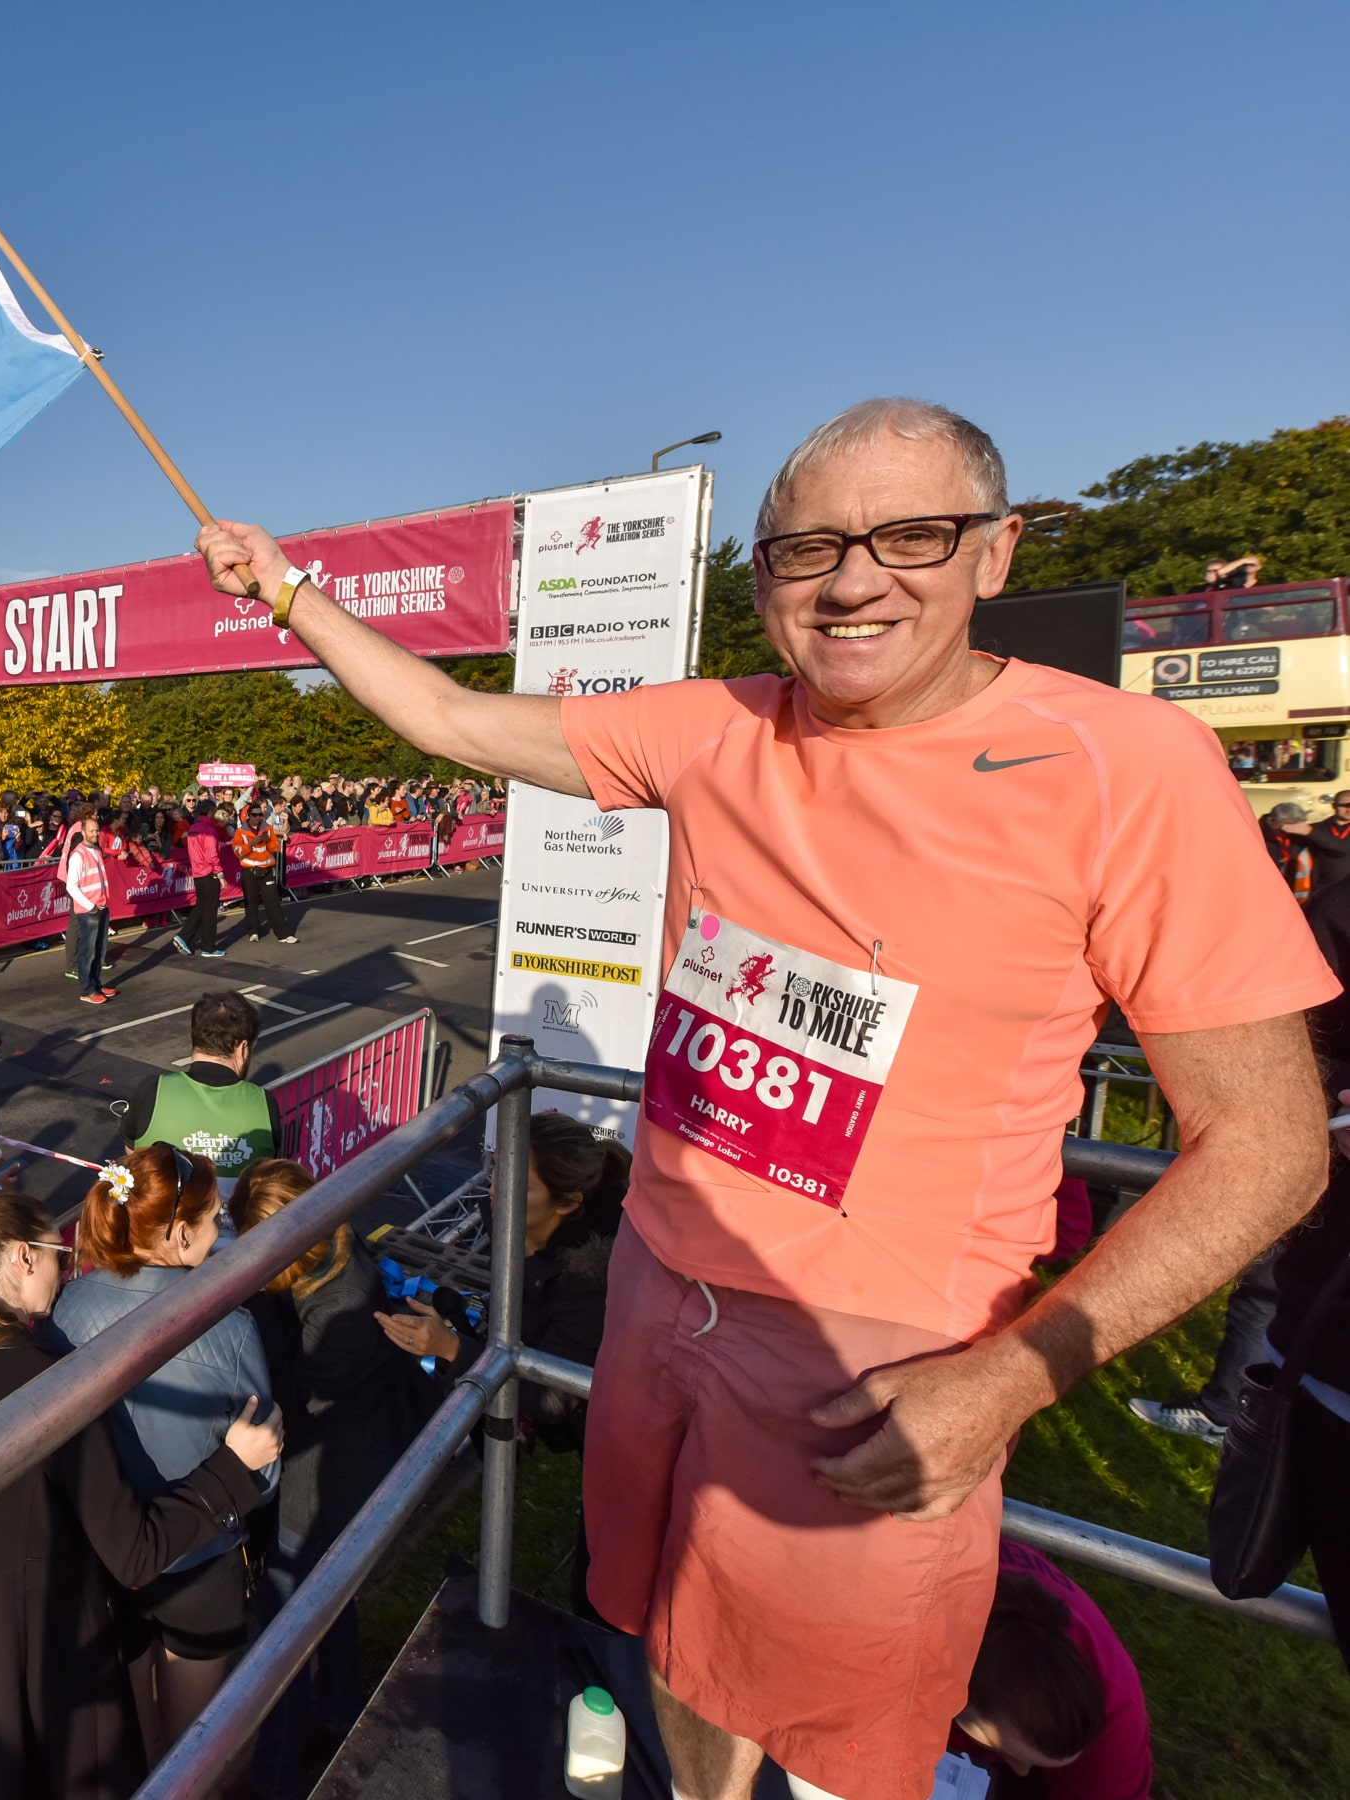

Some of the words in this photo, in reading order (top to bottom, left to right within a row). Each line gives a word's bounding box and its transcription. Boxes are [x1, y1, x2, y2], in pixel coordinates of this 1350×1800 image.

[606, 532, 640, 543] MARATHON
[642, 528, 665, 540] SERIES
[607, 523, 620, 534] THE
[623, 516, 666, 532] YORKSHIRE
[538, 541, 573, 554] plusnet
[334, 576, 359, 600] THE
[363, 565, 446, 596] YORKSHIRE
[537, 577, 577, 592] ASDA
[580, 573, 657, 588] FOUNDATION
[401, 591, 446, 613] SERIES
[4, 584, 123, 675] START
[214, 613, 273, 637] plusnet
[530, 624, 574, 639] BBC
[577, 622, 624, 634] RADIO
[628, 618, 670, 630] YORK
[1199, 660, 1217, 668] TO
[1218, 657, 1246, 667] HIRE
[1248, 655, 1278, 664] CALL
[1168, 689, 1200, 698] YORK
[1202, 686, 1261, 697] PULLMAN
[545, 830, 597, 842] Northern
[325, 851, 354, 867] MARATHON
[544, 842, 563, 852] Gas
[566, 843, 623, 856] Networks
[7, 905, 37, 925] plusnet
[516, 921, 587, 940] RUNNER'S
[589, 930, 636, 944] WORLD
[524, 955, 600, 977] YORKSHIRE
[602, 965, 639, 982] POST
[682, 957, 723, 984] plusnet
[543, 1000, 581, 1028] M
[778, 994, 806, 1030] 10
[807, 1008, 878, 1058] MILE
[666, 1009, 833, 1125] 10381
[690, 1094, 753, 1135] HARRY
[183, 1133, 238, 1150] charity
[679, 1123, 715, 1148] Baggage
[717, 1144, 741, 1161] Label
[767, 1162, 828, 1198] 10381
